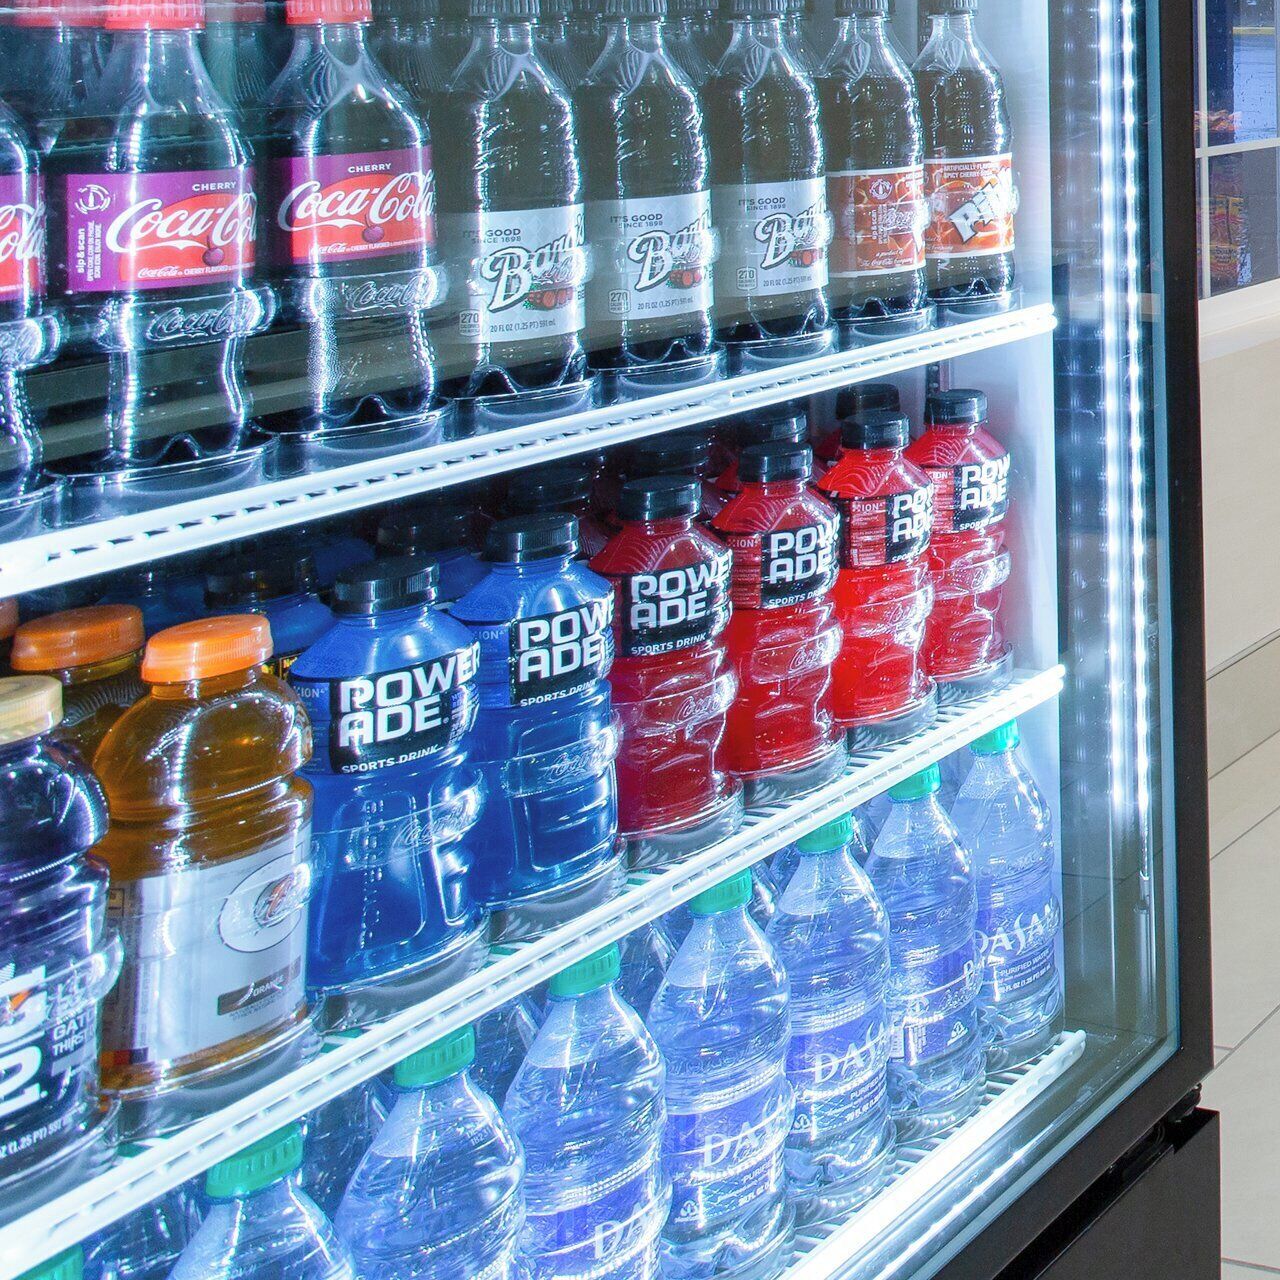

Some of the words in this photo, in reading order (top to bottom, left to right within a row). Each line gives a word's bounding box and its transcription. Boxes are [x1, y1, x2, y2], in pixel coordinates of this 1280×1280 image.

[348, 163, 392, 173] CHERRY
[192, 181, 237, 192] CHERRY
[277, 169, 435, 231] Coca-Cola
[757, 197, 786, 205] GOOD
[631, 213, 663, 222] GOOD
[486, 228, 521, 237] GOOD
[461, 312, 480, 323] 270
[770, 516, 839, 558] POW
[630, 548, 733, 603] POWE
[769, 593, 805, 607] SPORTS
[519, 593, 616, 652] POWE
[631, 641, 674, 656] SPORTS
[676, 632, 707, 648] DRINK
[520, 691, 567, 708] SPORTS
[341, 757, 396, 774] SPORTS
[397, 744, 440, 765] DRINK
[1001, 960, 1032, 976] PURIFIED
